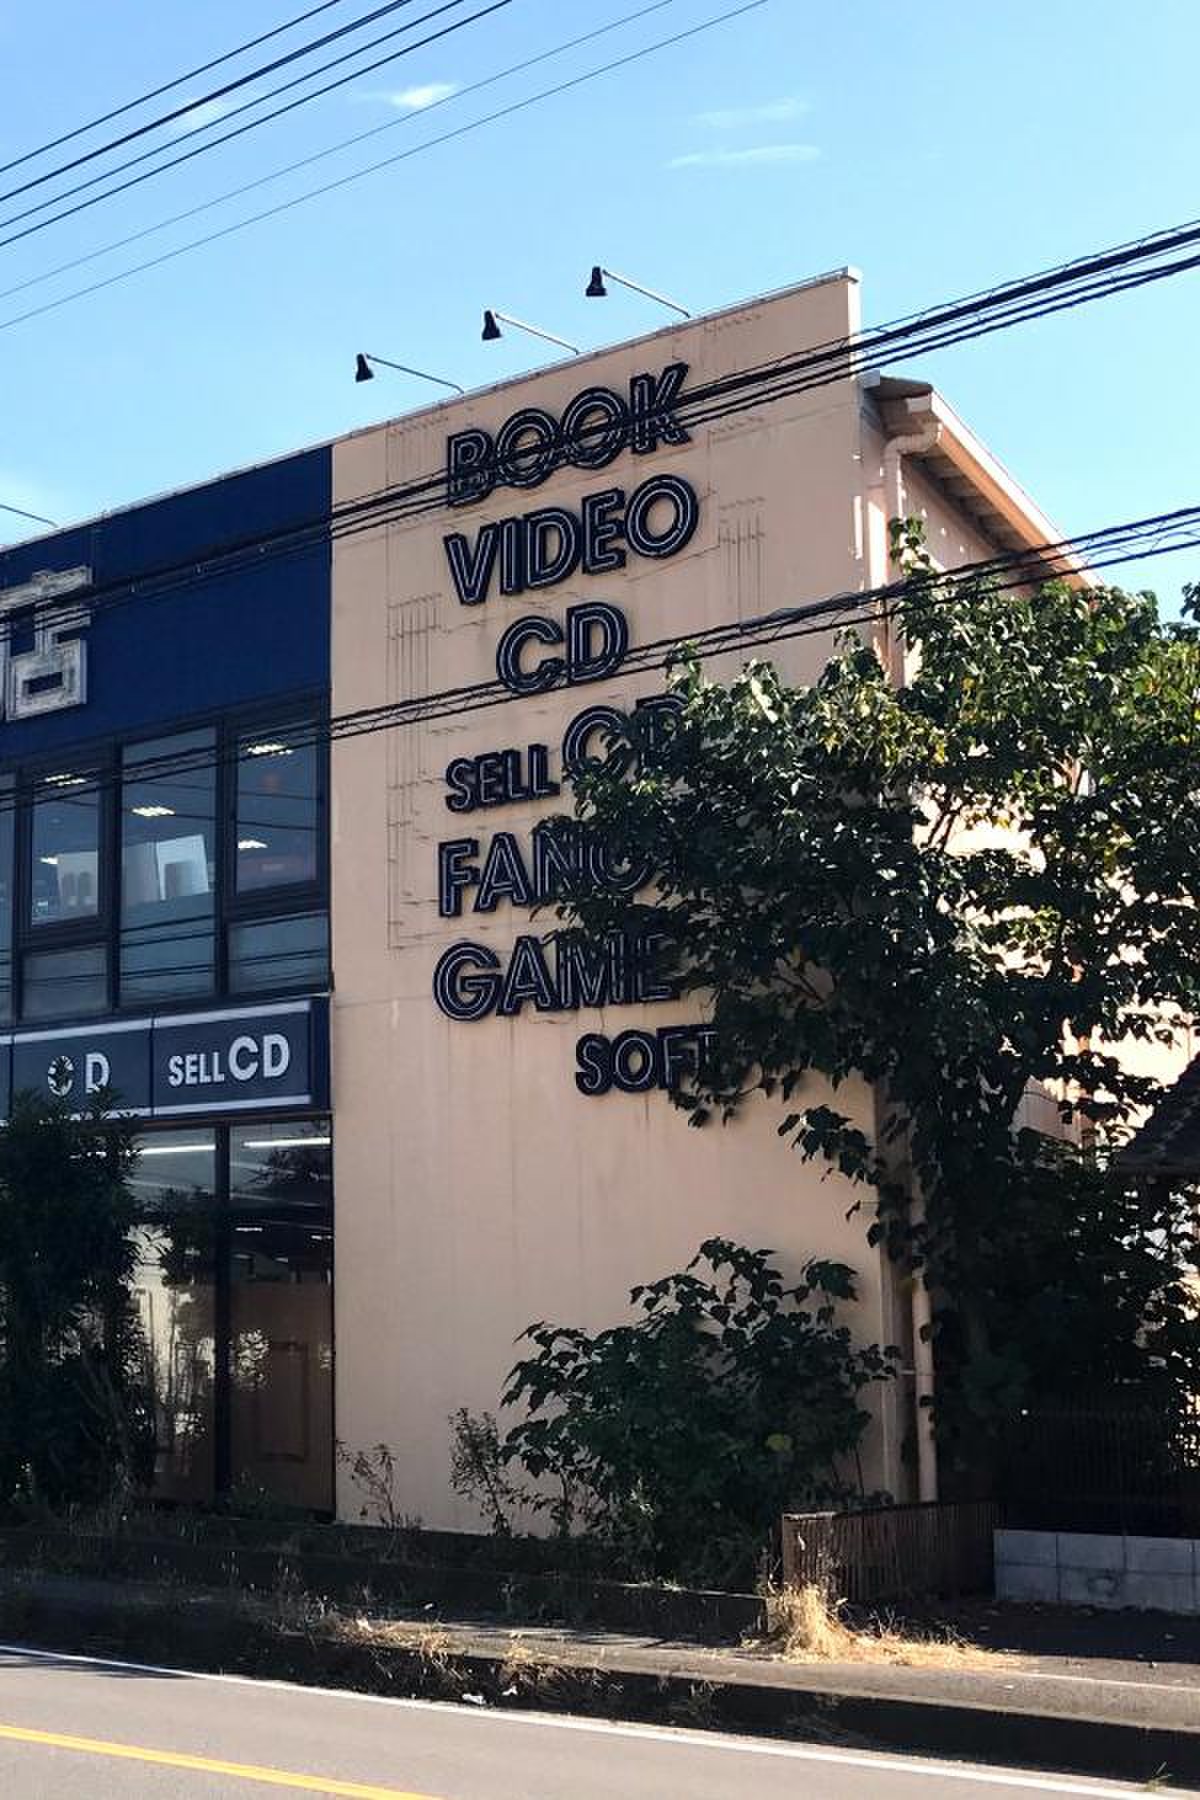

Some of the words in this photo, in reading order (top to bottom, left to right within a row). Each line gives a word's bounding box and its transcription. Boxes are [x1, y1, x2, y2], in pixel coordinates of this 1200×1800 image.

[447, 362, 692, 507] BOOK
[443, 474, 699, 606] VIDEO
[496, 602, 629, 694] CD
[445, 743, 560, 814] SELL
[433, 928, 682, 1021] GAME
[168, 1052, 225, 1087] SELL
[229, 1033, 290, 1082] CD
